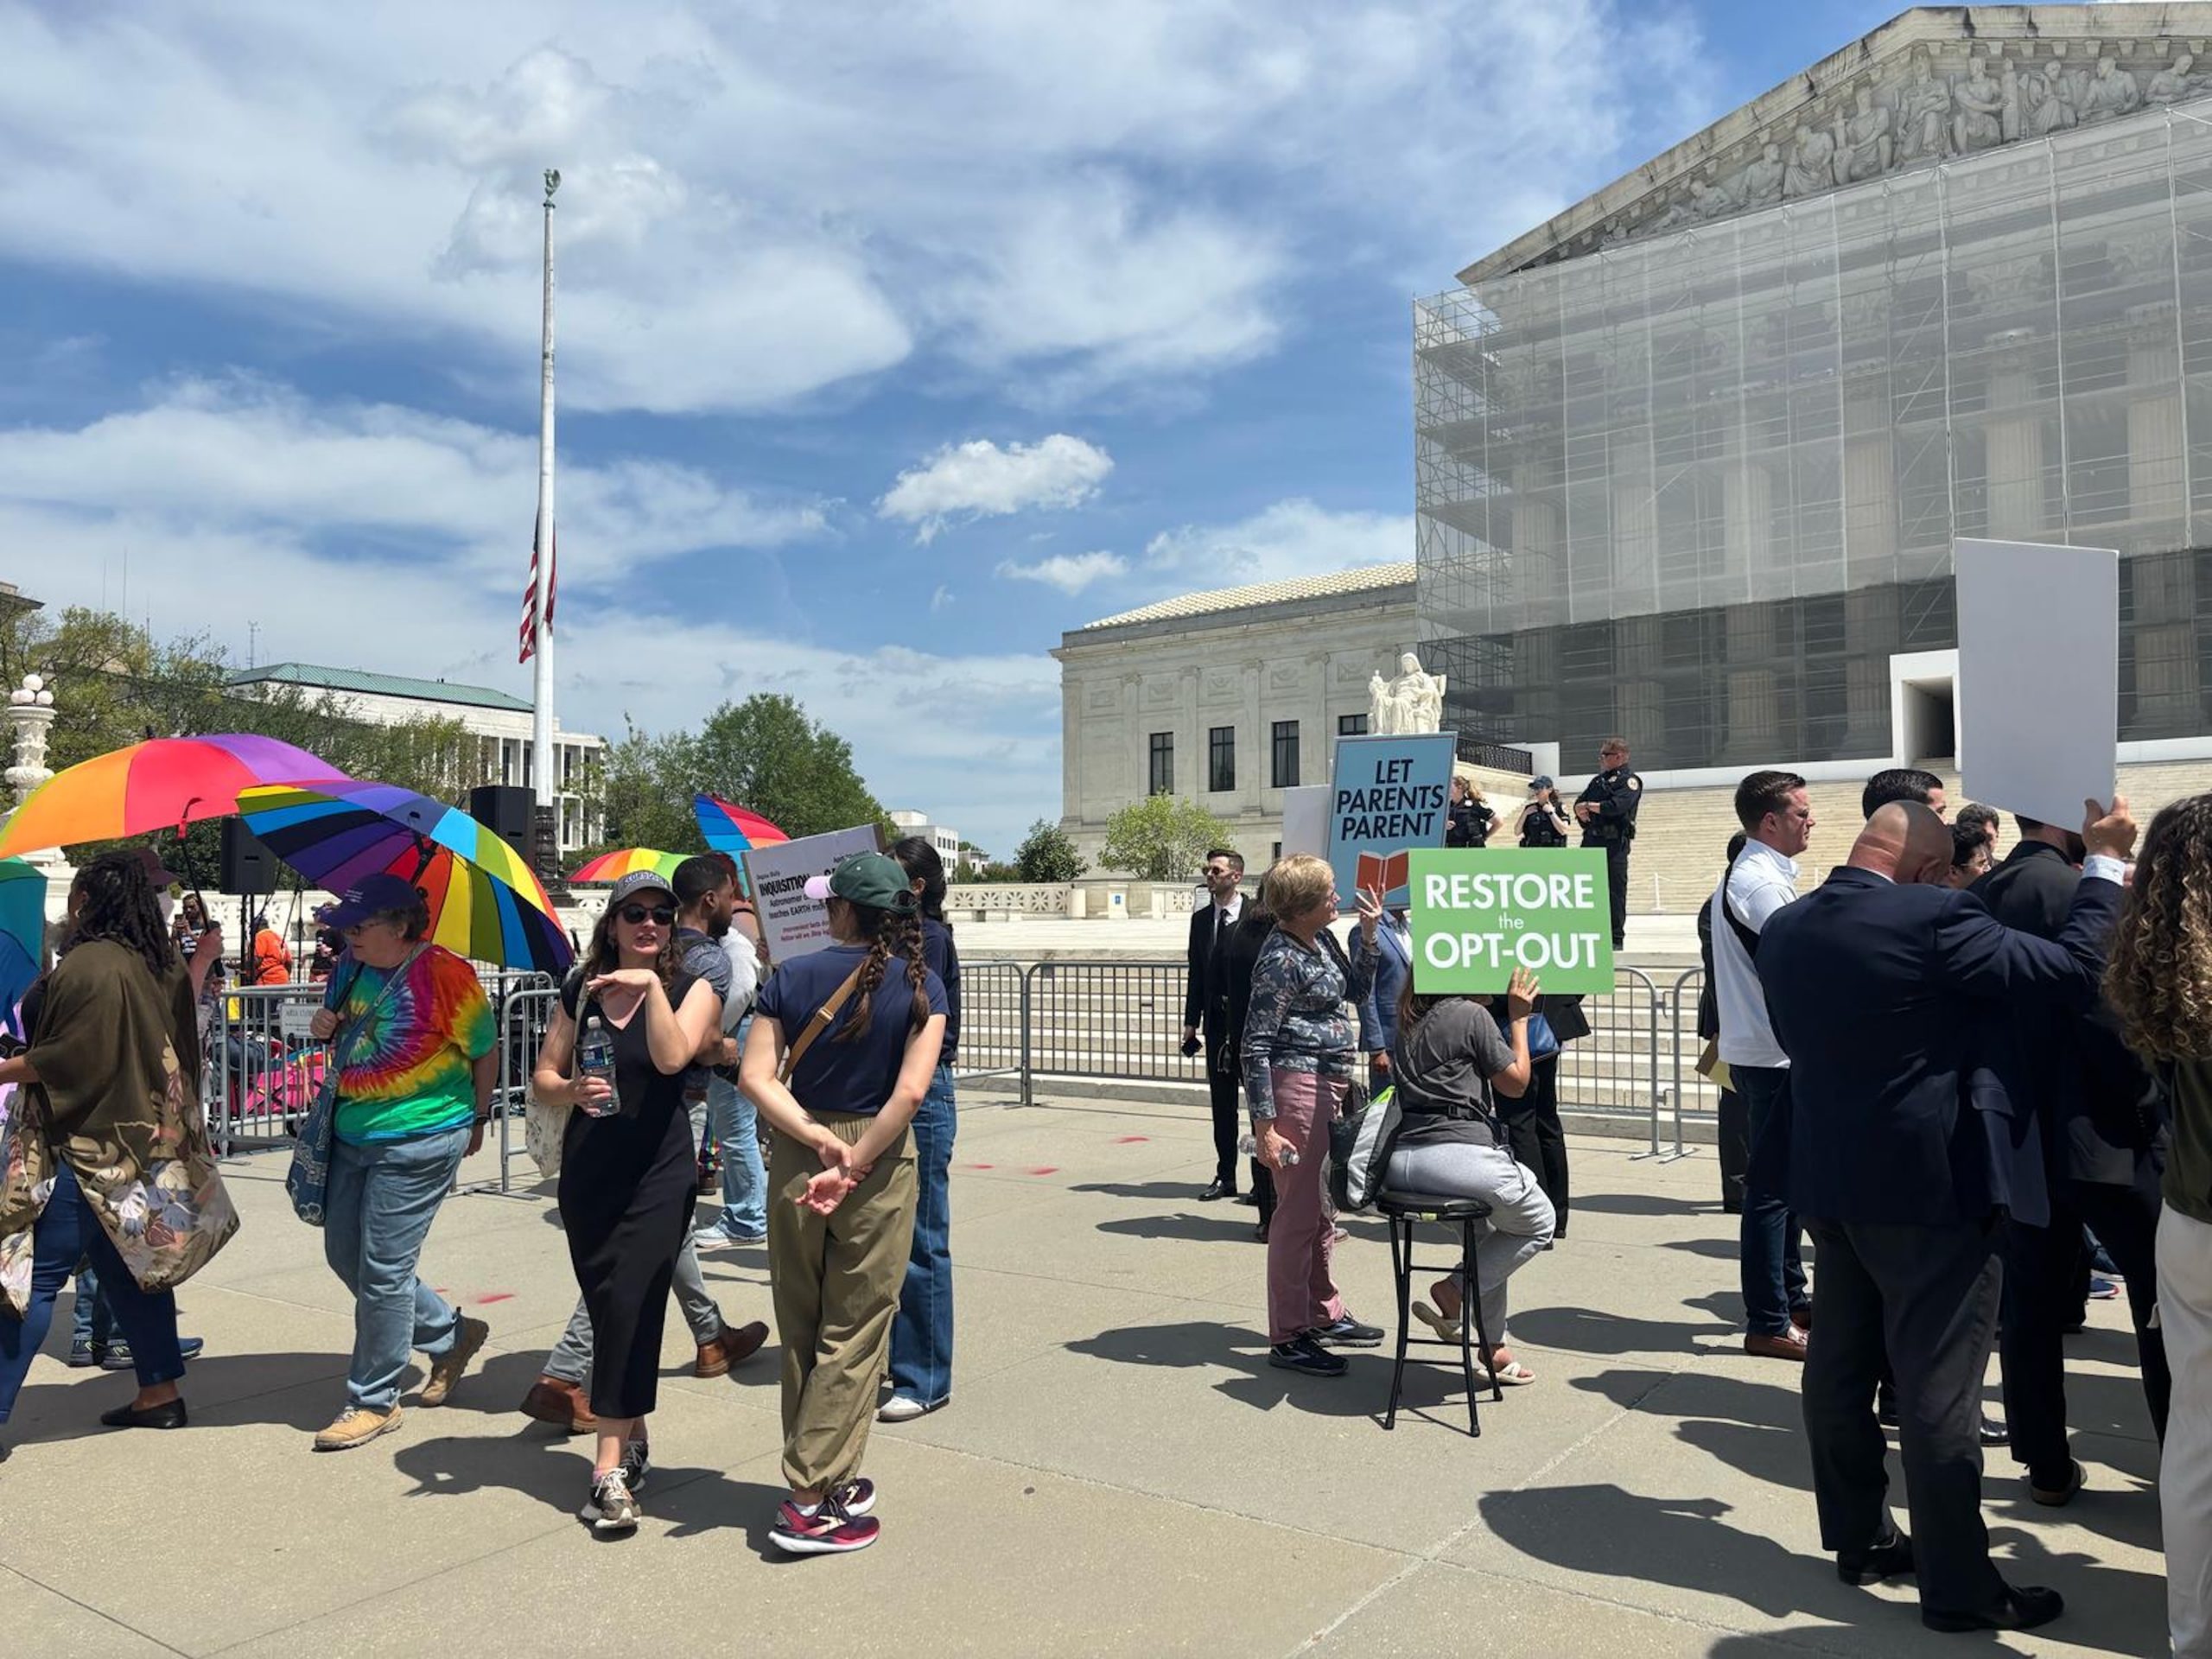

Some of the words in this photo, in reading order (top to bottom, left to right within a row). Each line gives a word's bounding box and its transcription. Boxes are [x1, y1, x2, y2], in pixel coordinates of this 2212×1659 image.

[1376, 759, 1414, 785] LET
[1337, 785, 1444, 814] PARENTS
[1341, 812, 1436, 841] PARENT
[1426, 874, 1595, 909] RESTORE
[1498, 912, 1524, 930] the
[1425, 932, 1600, 969] OPT-OUT
